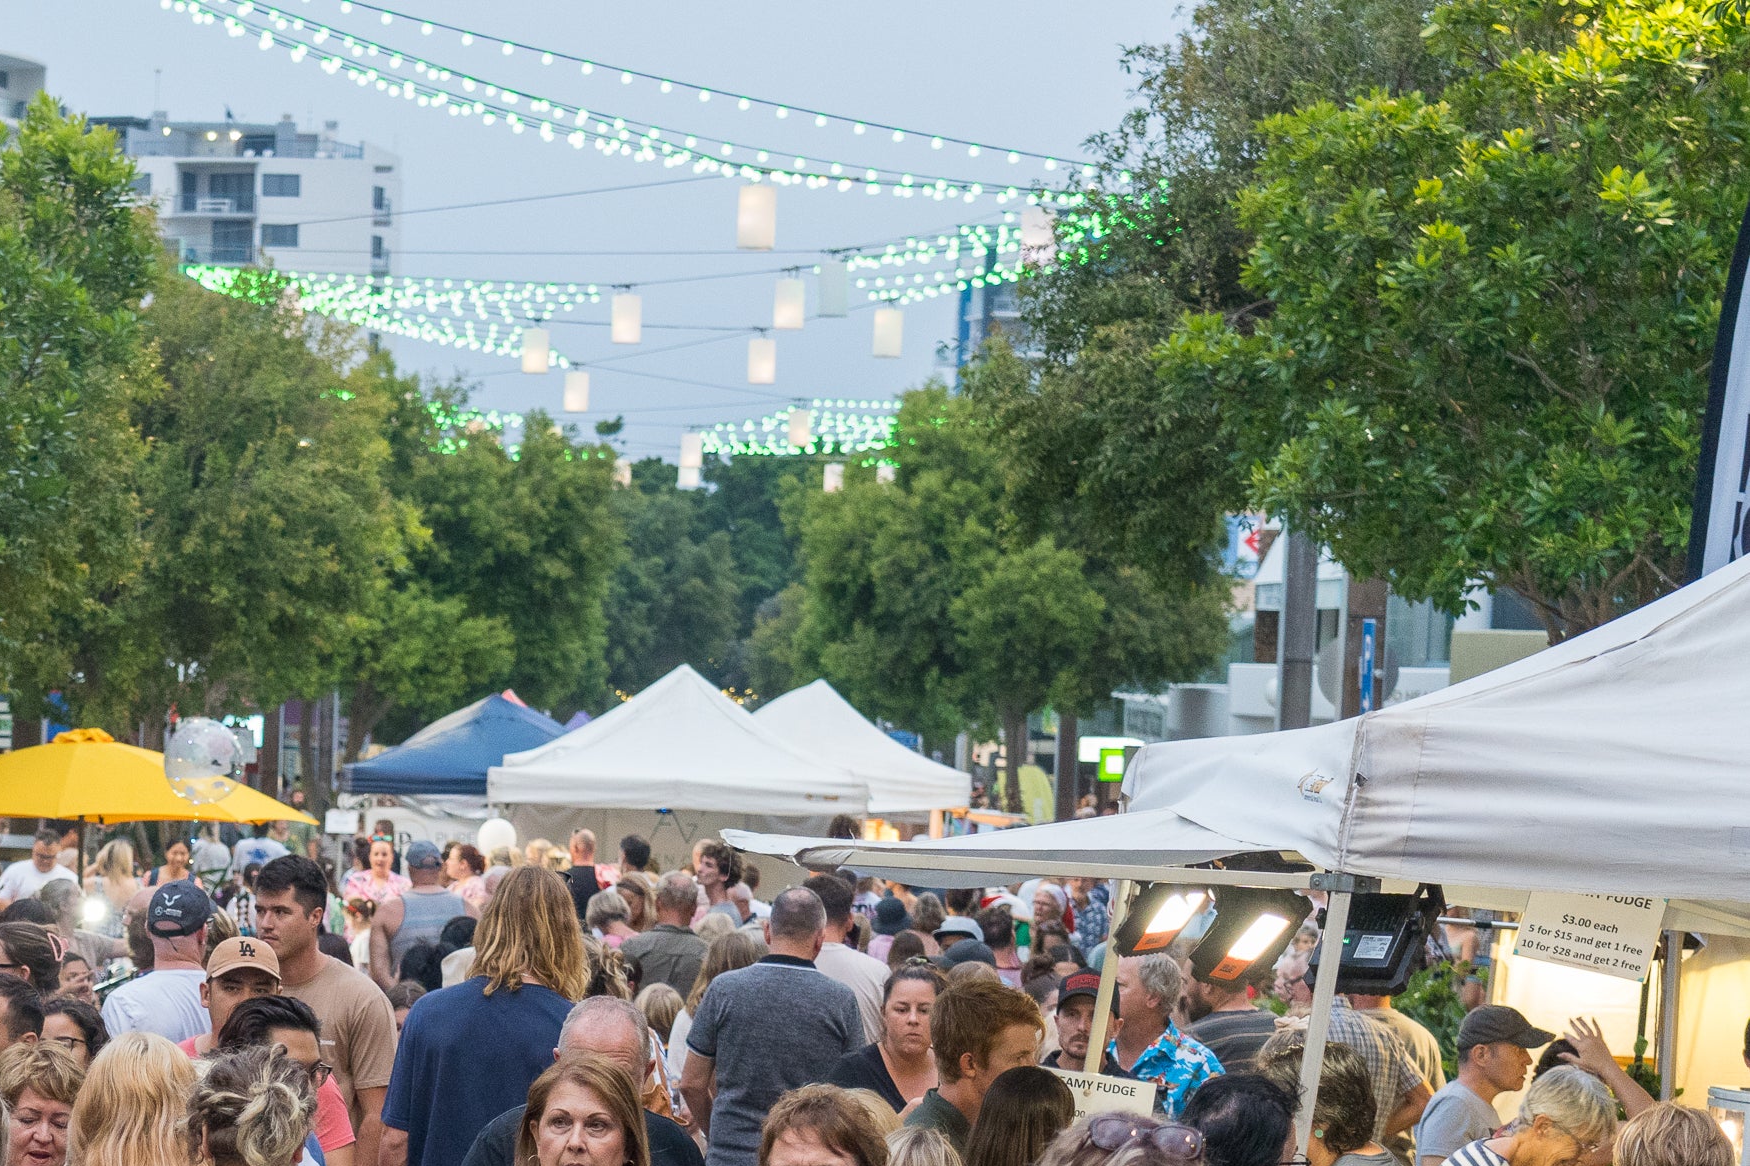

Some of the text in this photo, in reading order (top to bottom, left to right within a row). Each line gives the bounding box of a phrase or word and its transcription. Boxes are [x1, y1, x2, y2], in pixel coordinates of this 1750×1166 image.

[1562, 914, 1619, 934] $3.00 each
[1528, 924, 1644, 956] 5 for $15 and get 1 free
[1522, 939, 1534, 949] 10
[1536, 942, 1551, 953] for
[1553, 945, 1571, 958] $28
[1572, 950, 1592, 962] and
[1593, 954, 1611, 967] get
[1612, 958, 1619, 967] 2
[1621, 961, 1642, 973] free
[1060, 1075, 1137, 1097] AMY FUDGE
